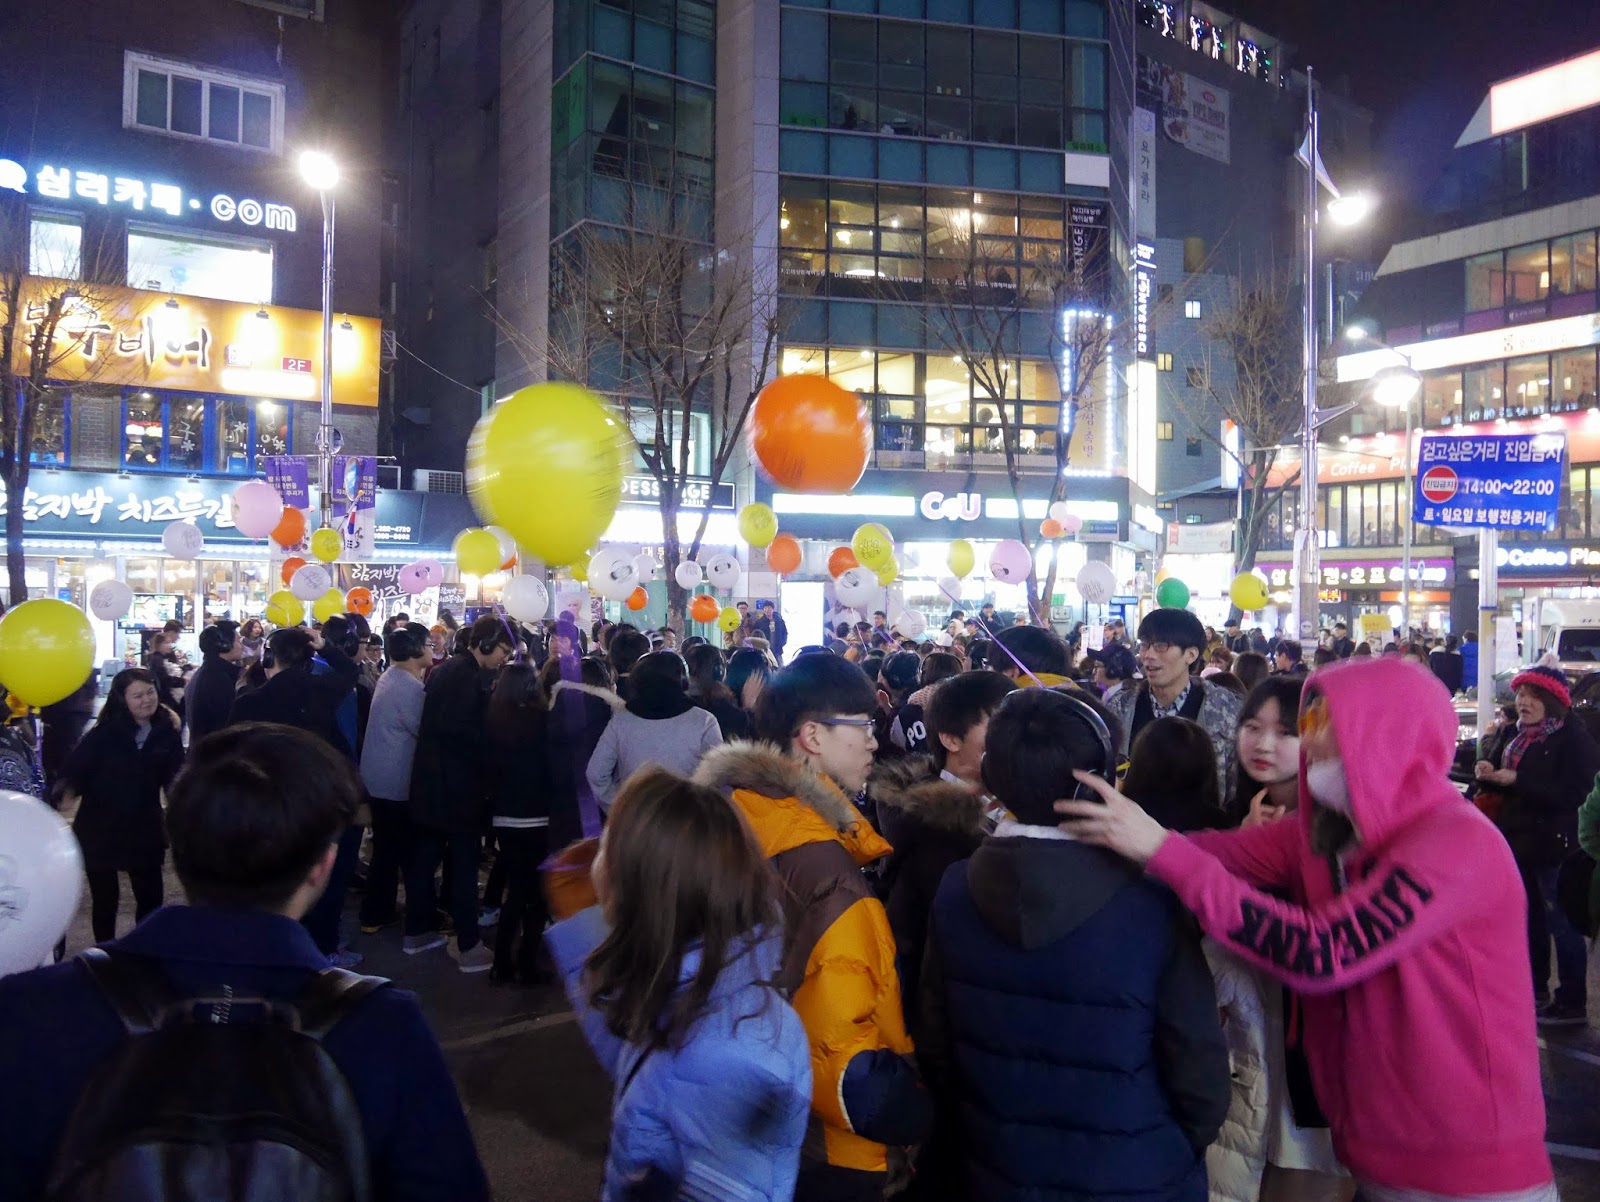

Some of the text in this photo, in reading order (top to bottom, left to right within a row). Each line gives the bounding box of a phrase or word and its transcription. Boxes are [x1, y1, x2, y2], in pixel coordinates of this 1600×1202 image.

[1137, 271, 1148, 353] DESSANGE
[287, 359, 306, 370] 2F
[1423, 440, 1500, 462] 걷고싶은거리
[1330, 462, 1377, 477] Coffee
[621, 480, 710, 499] DESSGE
[1425, 479, 1455, 490] 진입금지
[1464, 479, 1555, 496] 14:00~22:00
[1476, 508, 1547, 526] 보행전용거리
[1508, 548, 1568, 566] Coffee
